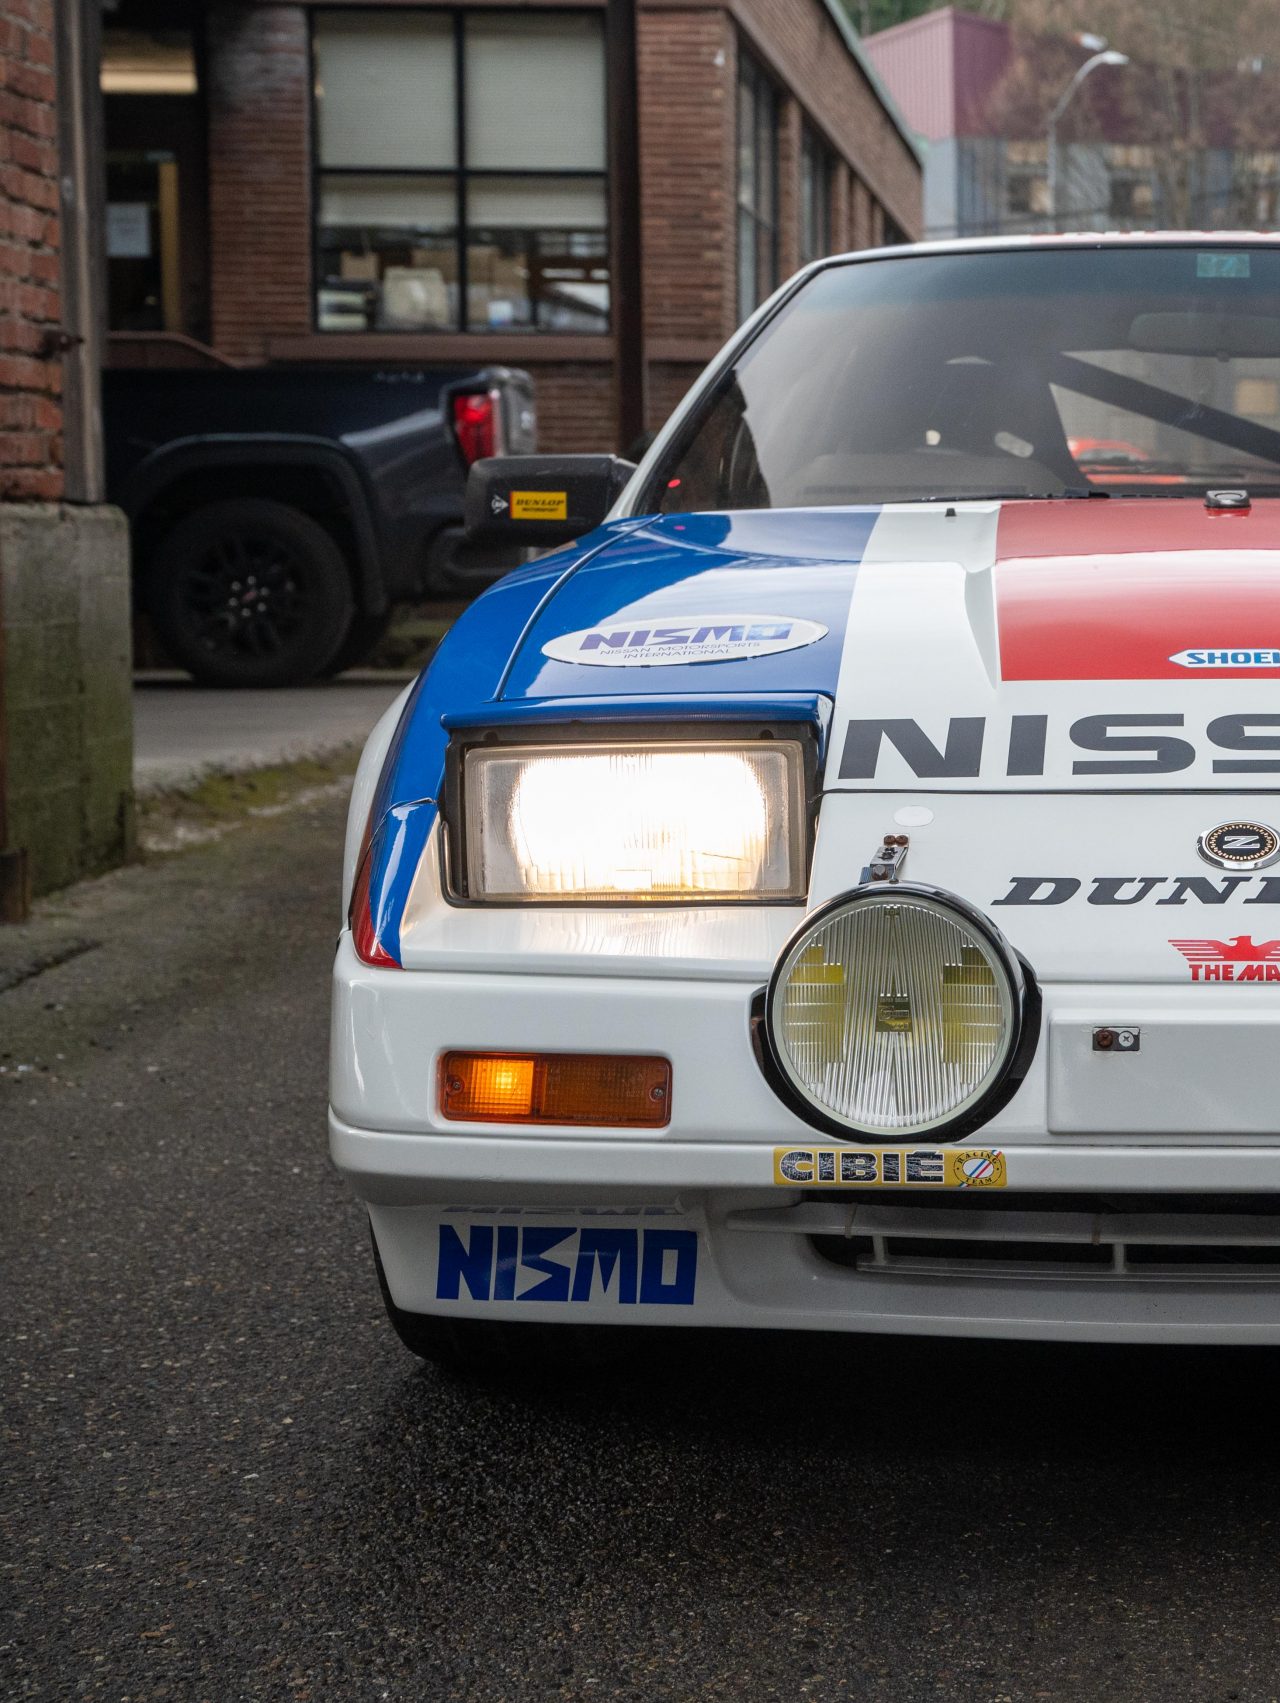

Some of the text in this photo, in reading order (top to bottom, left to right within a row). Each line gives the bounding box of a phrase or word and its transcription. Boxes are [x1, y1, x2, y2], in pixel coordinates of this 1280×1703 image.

[579, 623, 794, 650] NISMO
[600, 642, 761, 655] NISSAN MOTORSPORTS
[624, 648, 731, 659] INTERNATIONAL
[1186, 652, 1280, 665] SHOEI
[1222, 835, 1260, 849] Z
[1189, 964, 1234, 981] THE
[957, 1151, 998, 1164] RACING
[436, 1224, 698, 1305] NISMO
